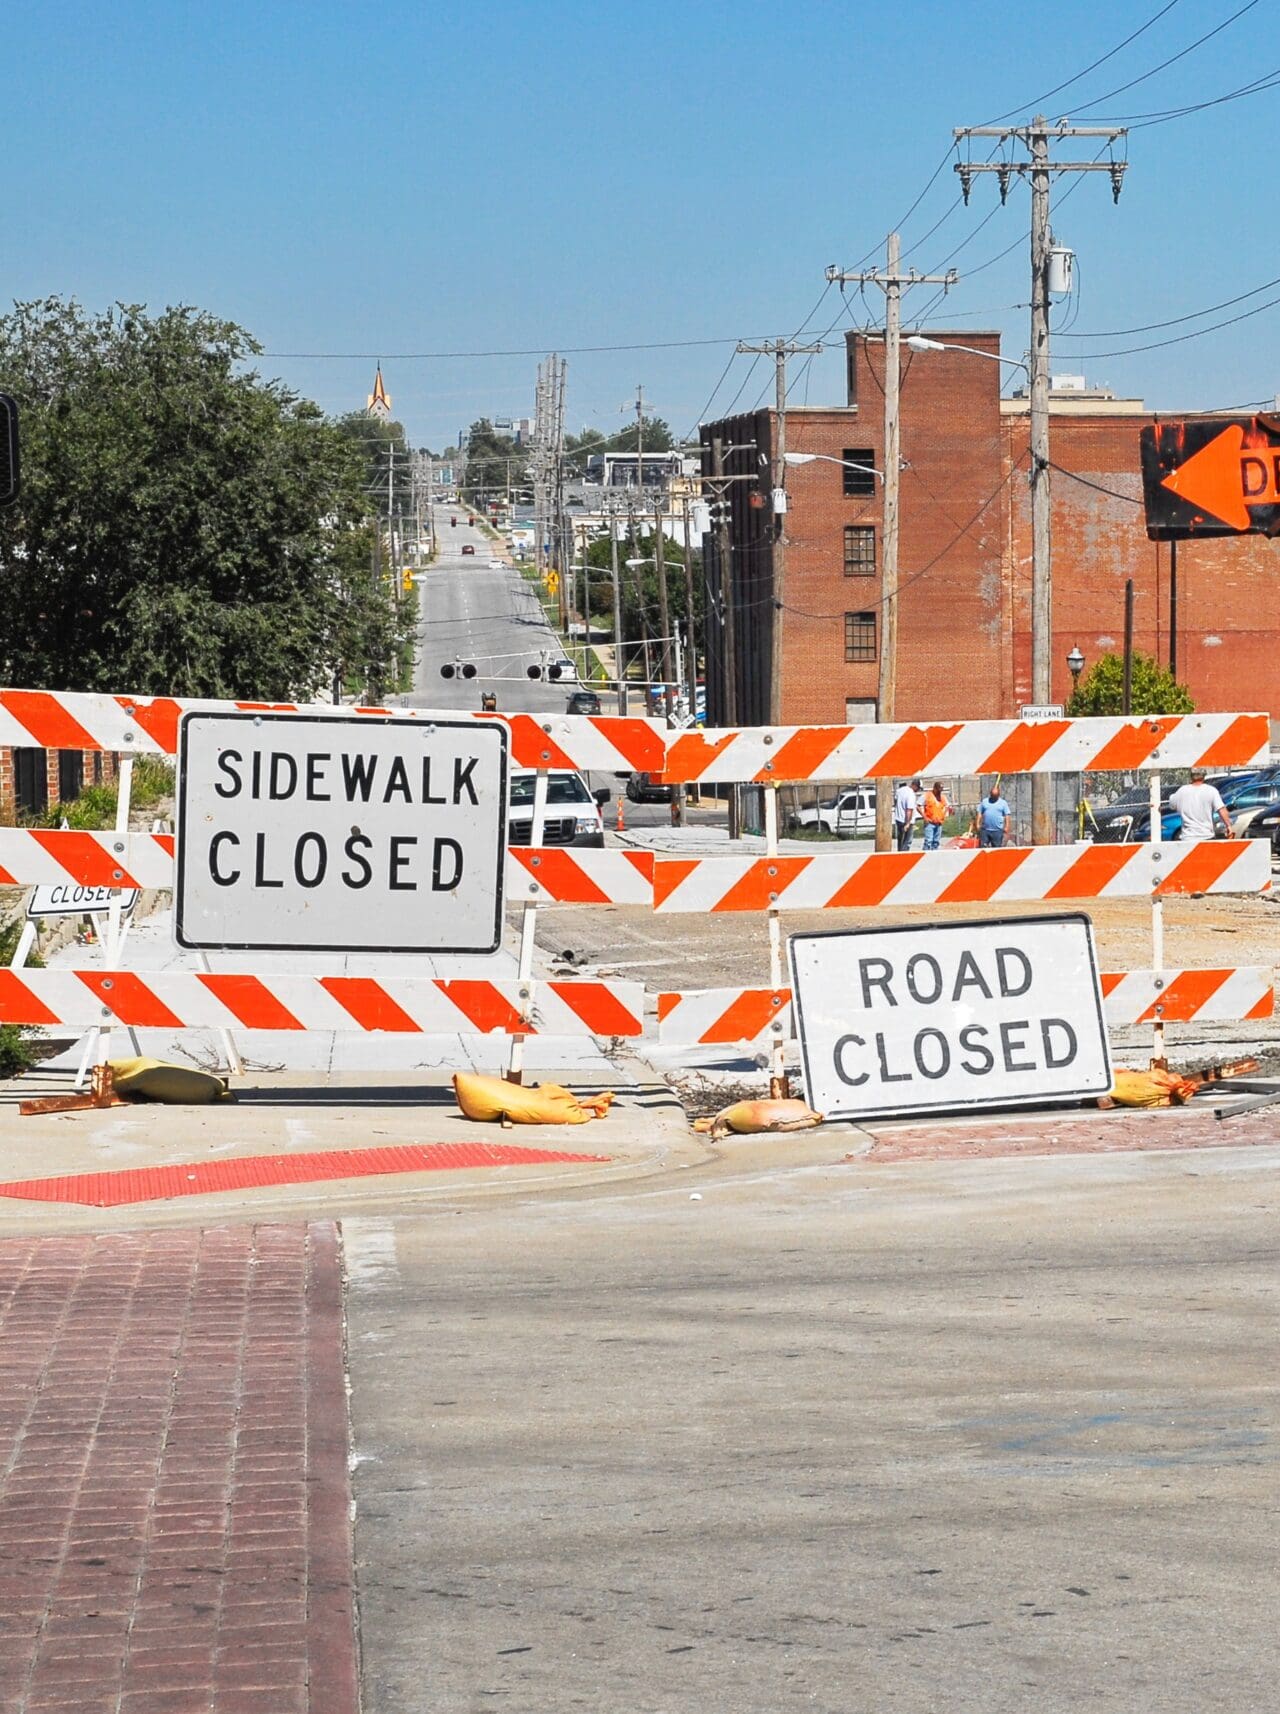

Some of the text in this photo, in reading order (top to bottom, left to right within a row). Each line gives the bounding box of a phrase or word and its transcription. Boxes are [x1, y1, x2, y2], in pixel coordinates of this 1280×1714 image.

[214, 749, 479, 806] SIDEWALK
[209, 828, 464, 892] CLOSED
[50, 886, 112, 904] CLOSE
[858, 946, 1032, 1009] ROAD
[833, 1017, 1078, 1087] CLOSED
